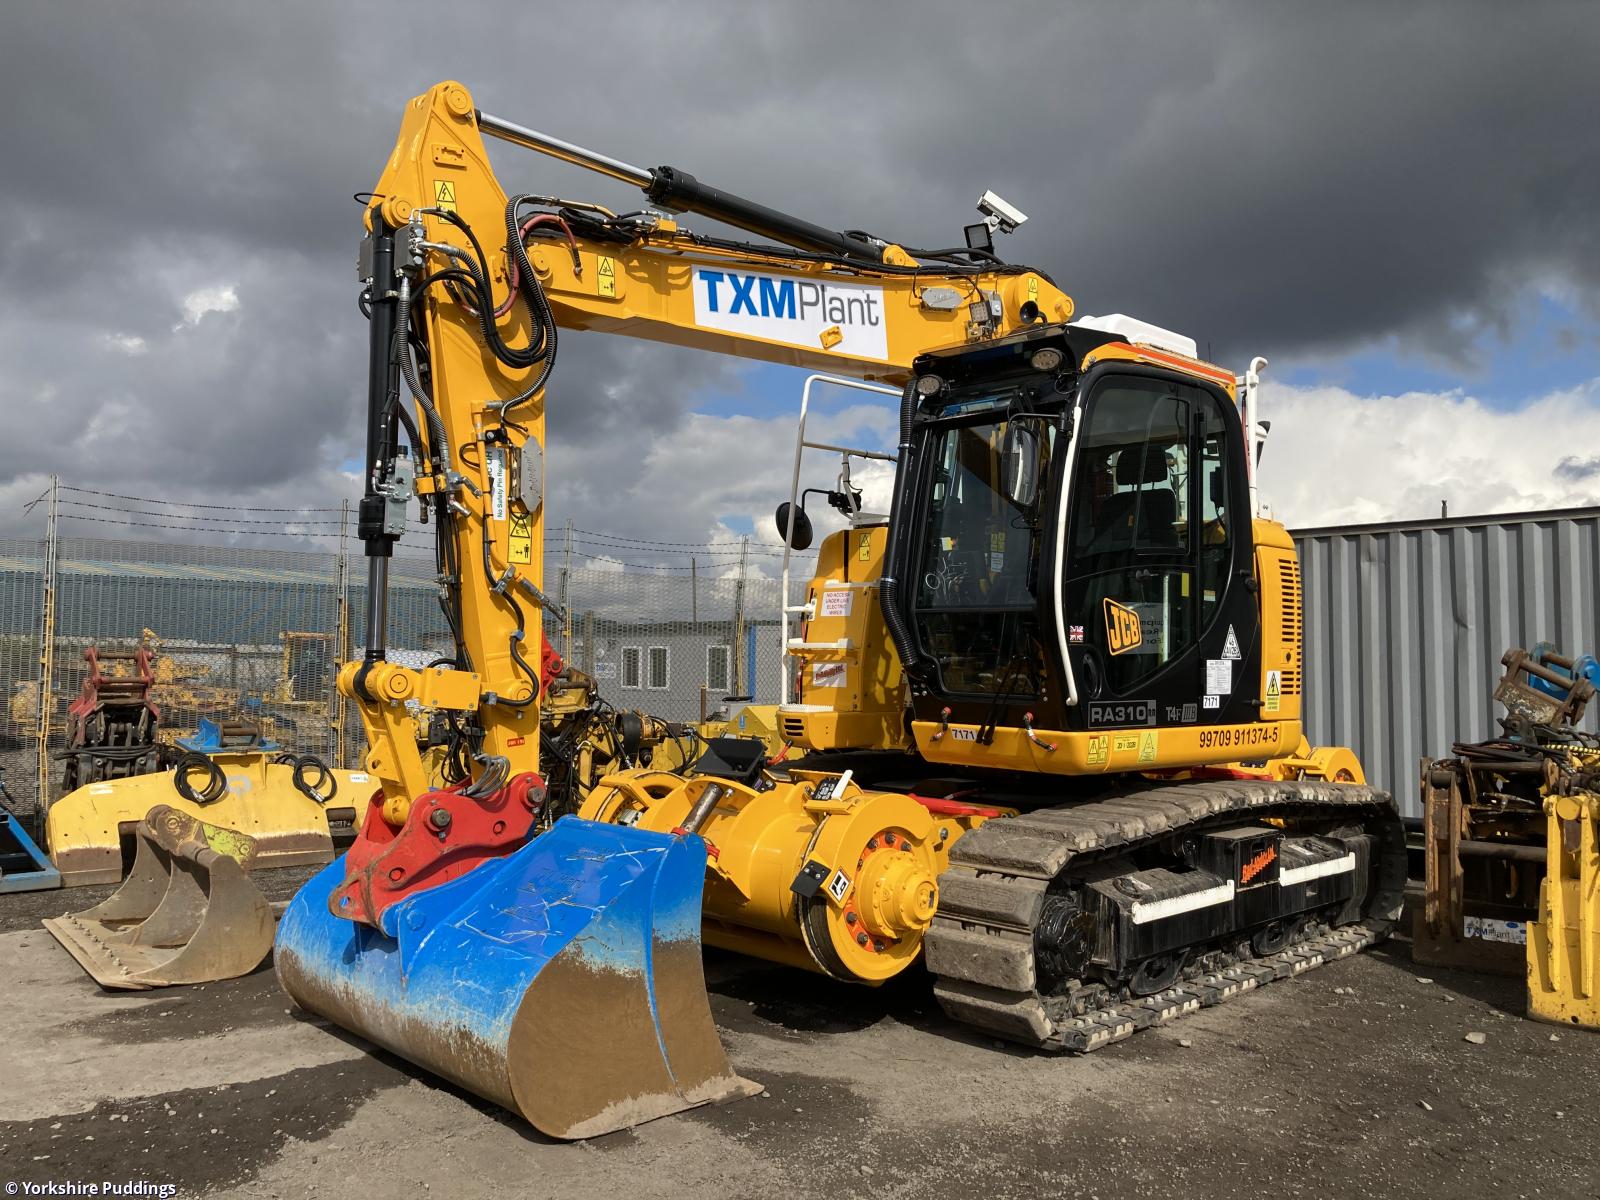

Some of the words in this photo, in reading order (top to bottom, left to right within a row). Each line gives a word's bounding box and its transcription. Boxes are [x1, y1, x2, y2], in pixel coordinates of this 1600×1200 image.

[699, 270, 879, 326] TXMPlant
[1109, 605, 1140, 650] JCB
[1204, 696, 1218, 707] 7171
[1091, 706, 1147, 722] RA310
[952, 729, 975, 740] 7171
[1199, 730, 1231, 748] 99709
[1234, 727, 1279, 746] 911374-5
